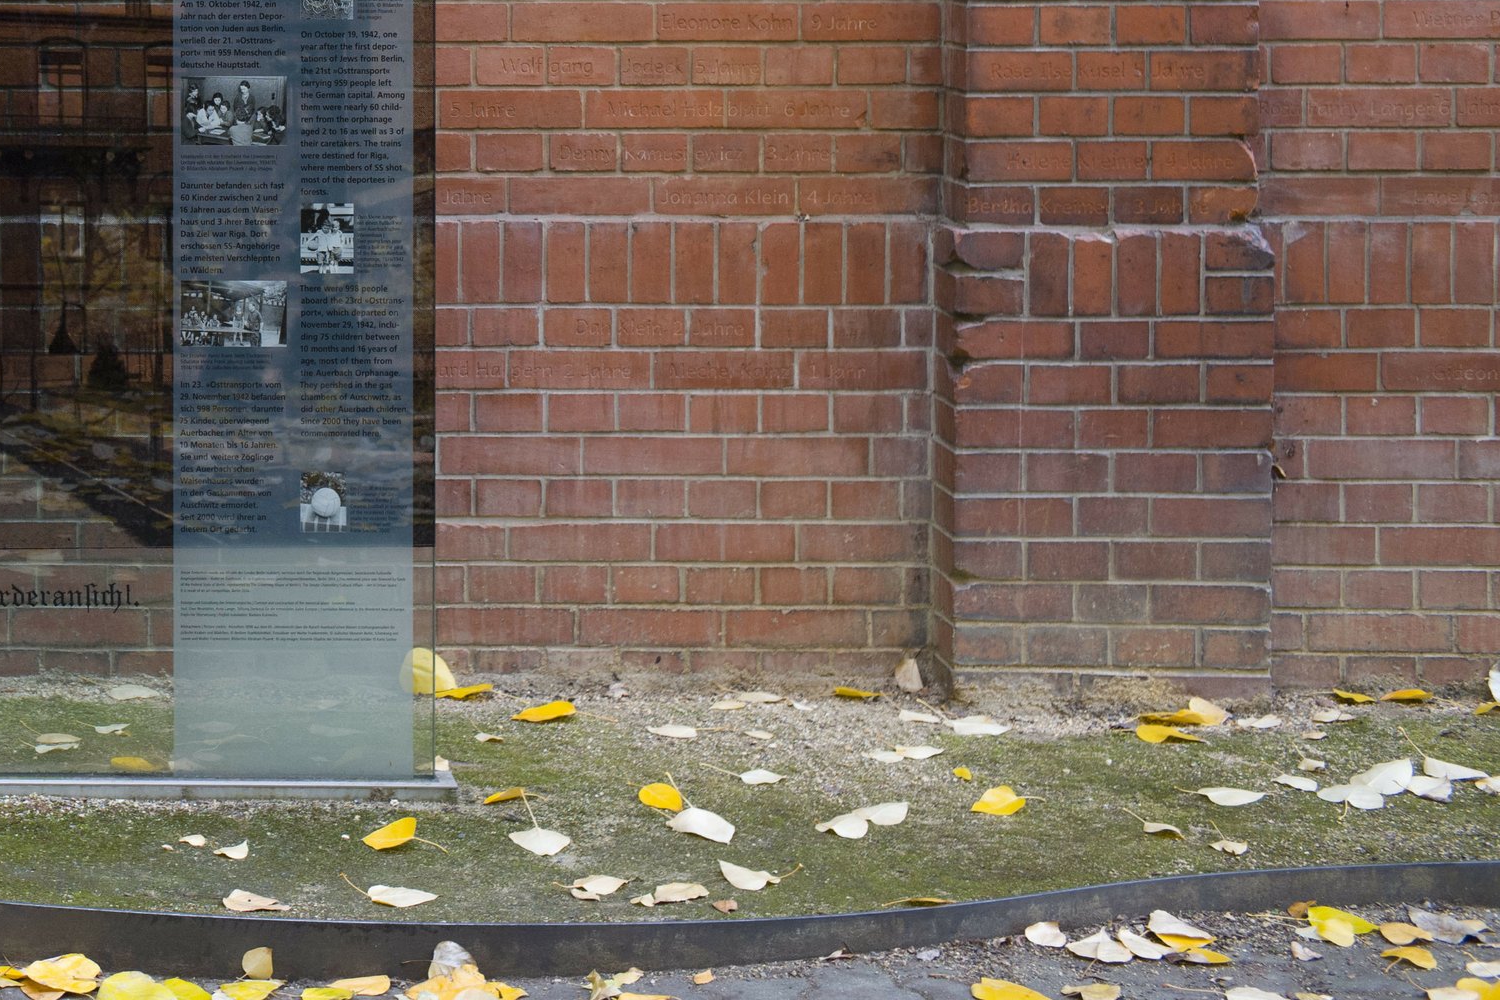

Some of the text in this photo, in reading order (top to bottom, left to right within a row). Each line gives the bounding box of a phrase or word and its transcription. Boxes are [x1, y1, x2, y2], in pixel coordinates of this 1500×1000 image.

[180, 0, 194, 8] Am
[208, 0, 240, 8] Oktober
[265, 0, 276, 8] ein
[660, 14, 740, 32] Eleonore
[747, 14, 794, 31] Kohn
[826, 14, 878, 31] Jahre
[301, 30, 312, 39] On
[315, 30, 344, 39] October
[180, 60, 215, 69] deutsche
[606, 100, 677, 117] Michael
[799, 100, 850, 117] Jahre
[180, 181, 284, 190] Darunter befanden sich fast
[745, 188, 790, 205] Klein
[823, 189, 873, 205] Jahre
[300, 320, 340, 329] November
[301, 368, 313, 377] the
[316, 368, 352, 377] Auerbach
[180, 500, 219, 509] Auschwitz
